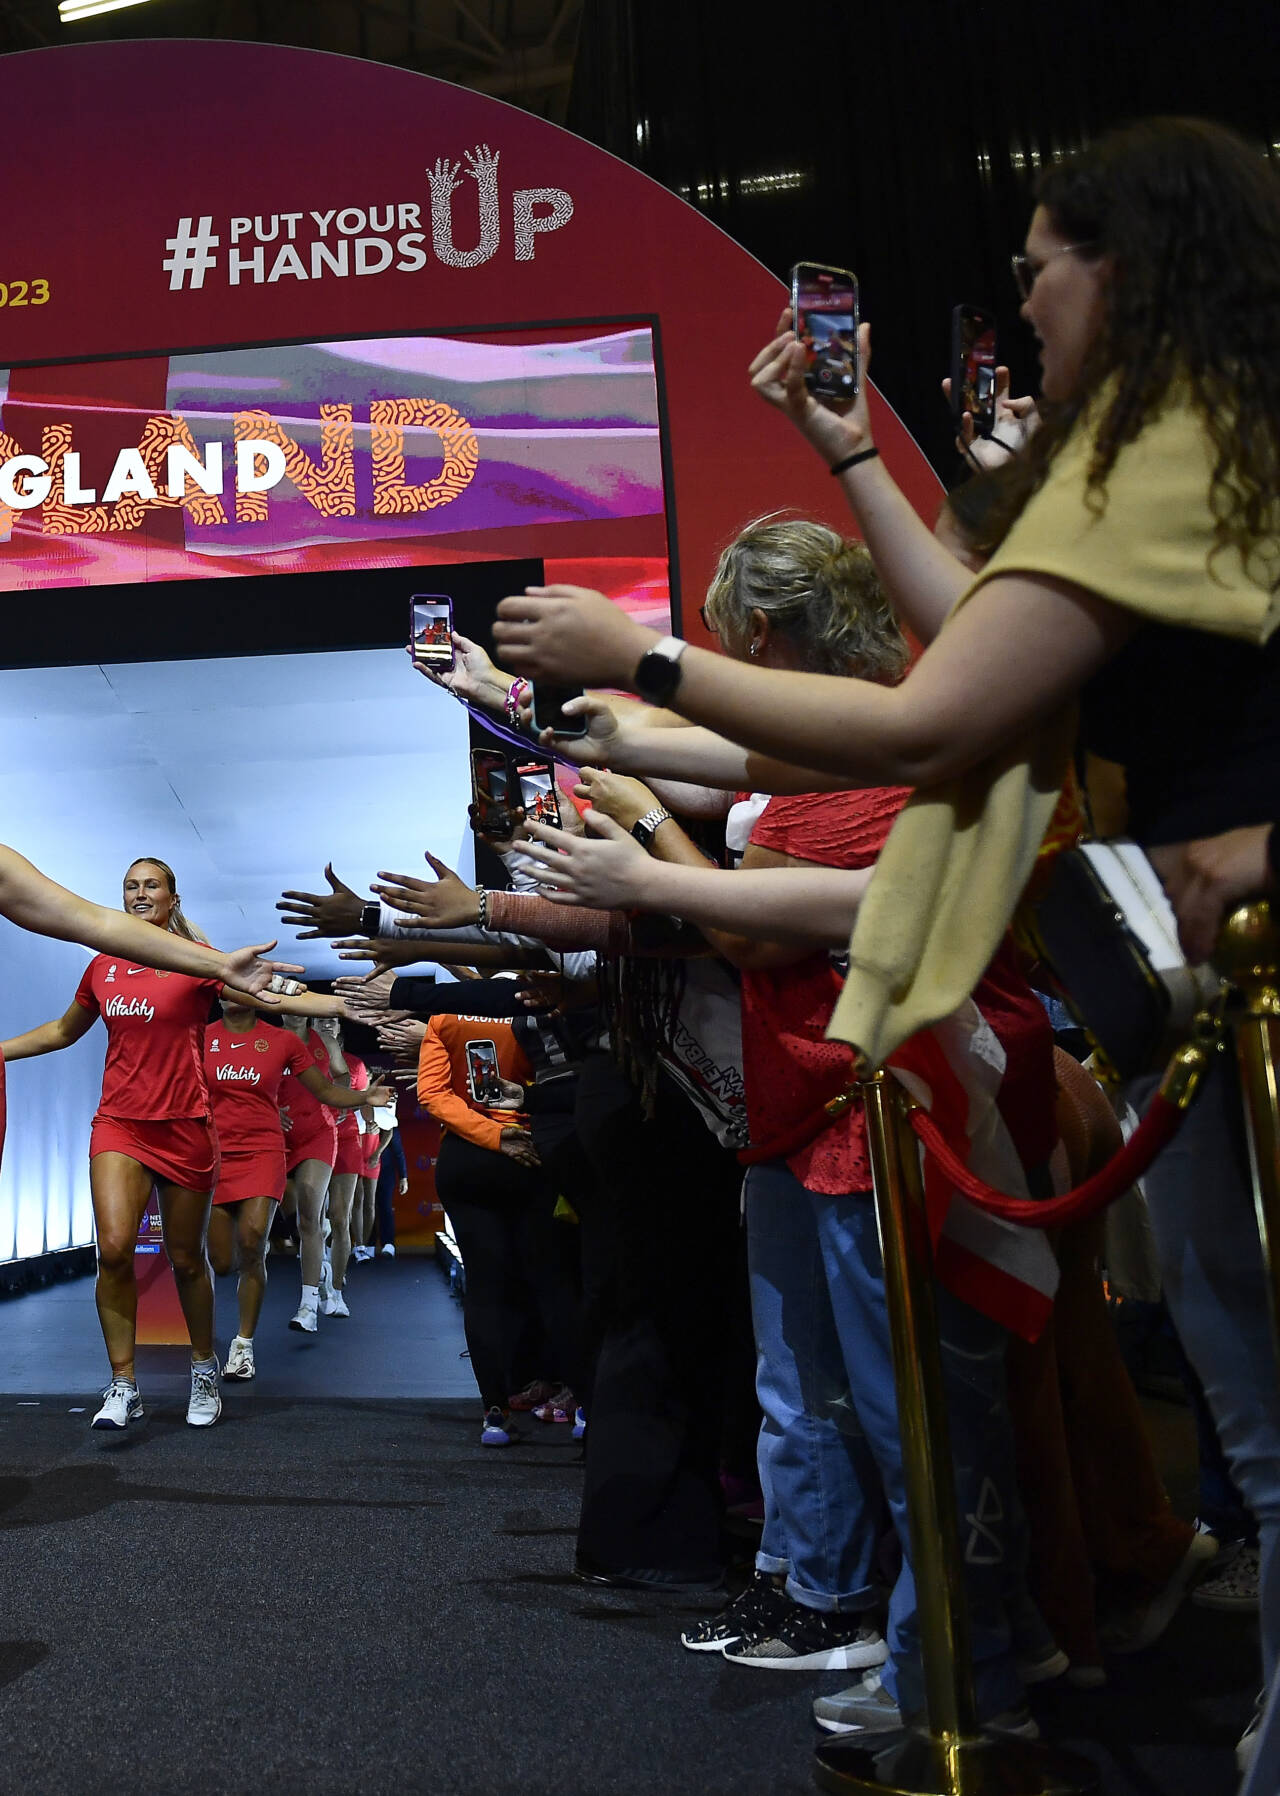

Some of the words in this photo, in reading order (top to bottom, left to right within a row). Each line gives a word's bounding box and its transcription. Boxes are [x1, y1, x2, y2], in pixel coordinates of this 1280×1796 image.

[230, 212, 304, 244] PUT
[310, 202, 422, 235] YOUR
[228, 232, 428, 286] HANDS
[105, 994, 155, 1023] Vitality
[457, 1014, 514, 1025] VOLUNTE
[216, 1063, 261, 1086] Vitality
[673, 1018, 733, 1102] NETBA
